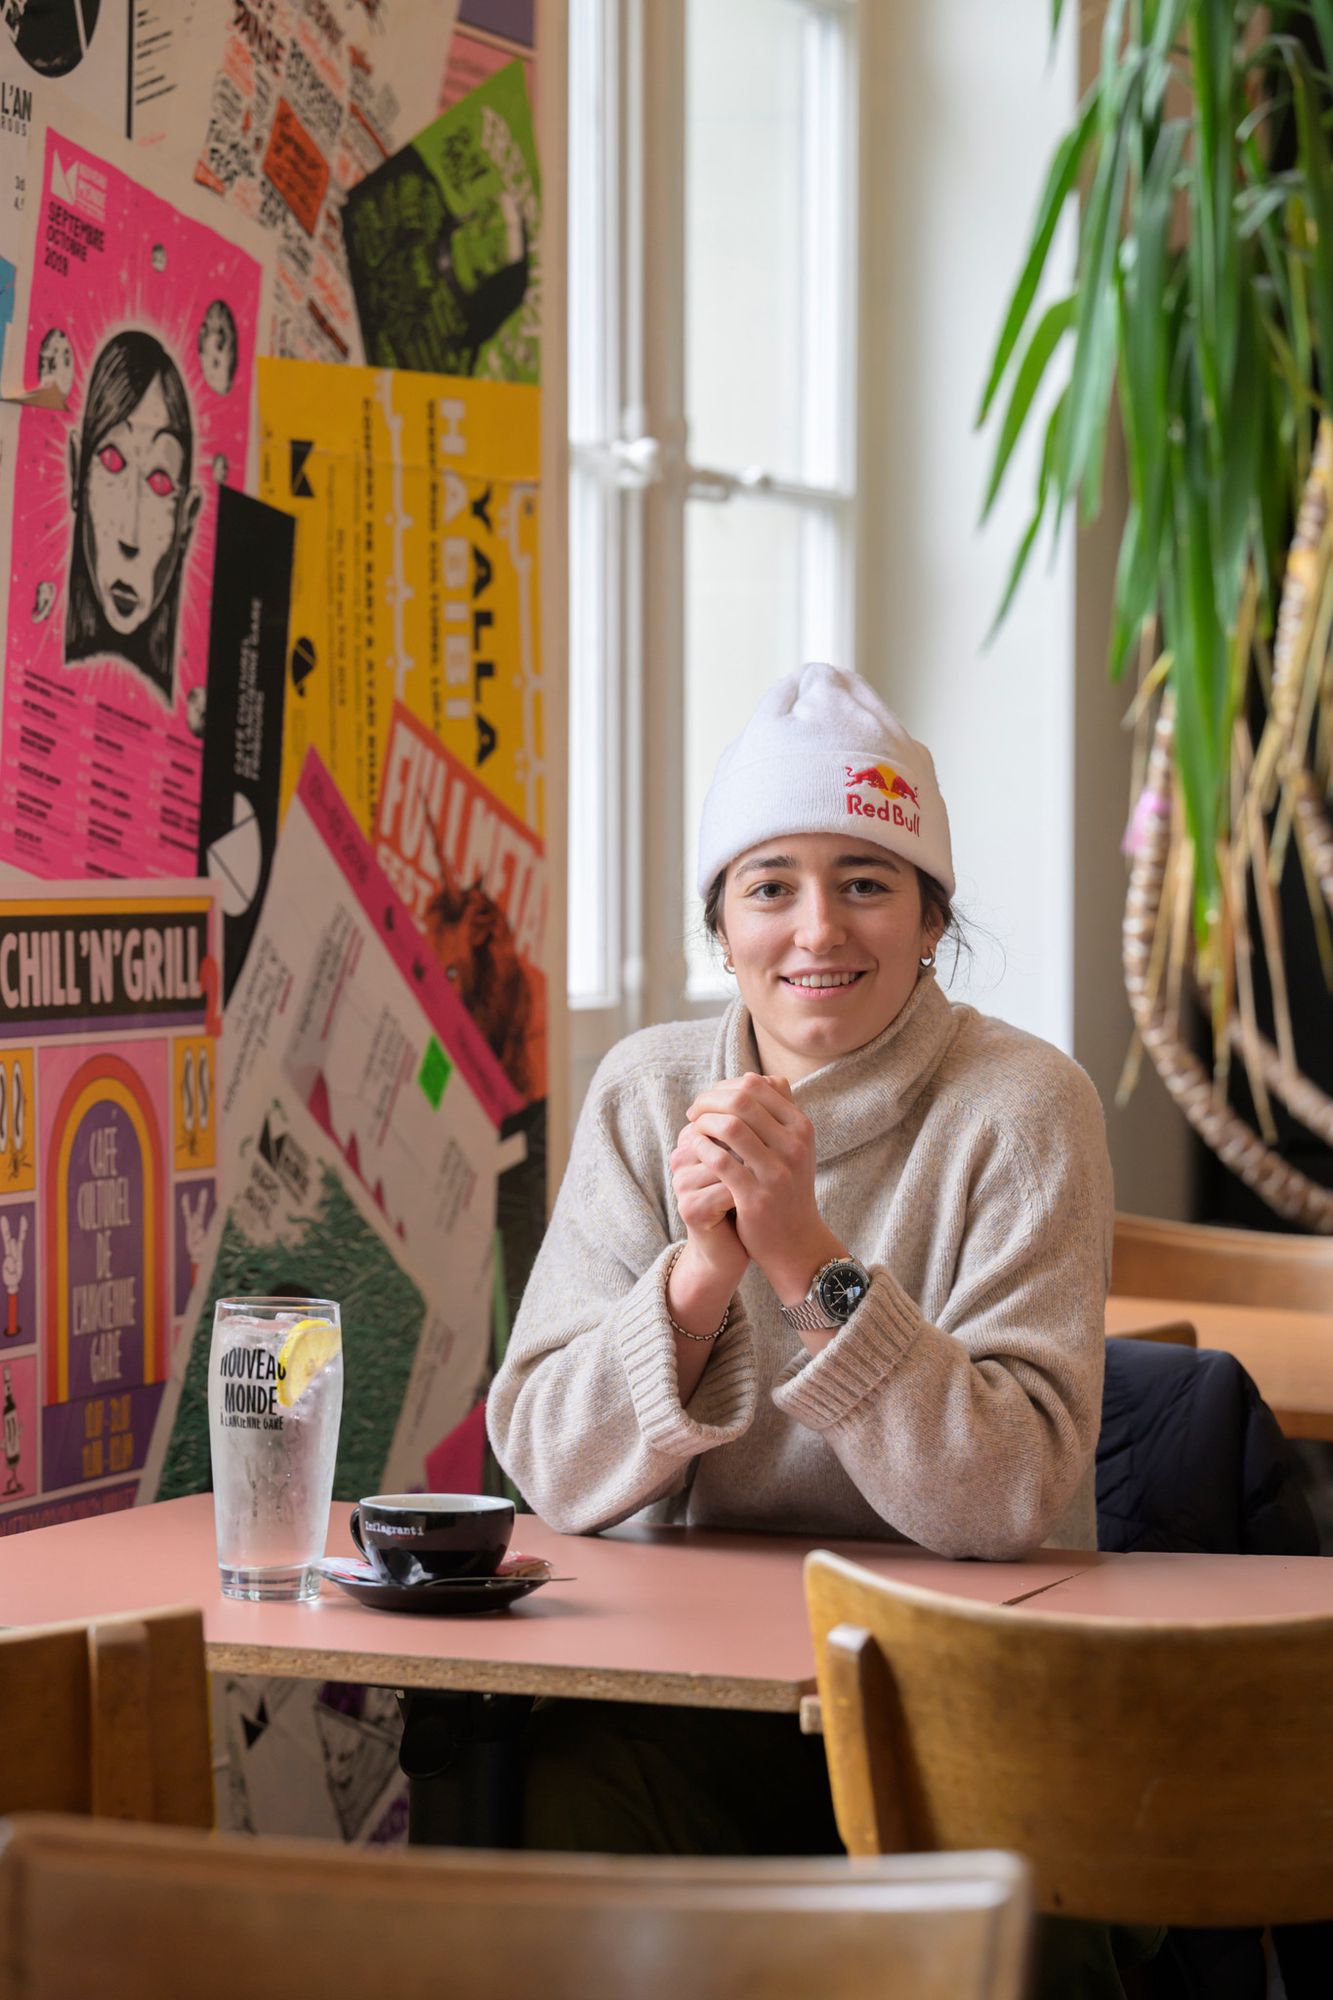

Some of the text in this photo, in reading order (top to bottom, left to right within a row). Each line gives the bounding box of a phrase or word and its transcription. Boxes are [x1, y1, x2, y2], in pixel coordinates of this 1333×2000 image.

[441, 399, 470, 719] HABIBI
[472, 483, 498, 768] YALLA
[847, 793, 920, 838] Red Bull
[224, 1382, 278, 1416] MONDE
[262, 1415, 284, 1431] GARE
